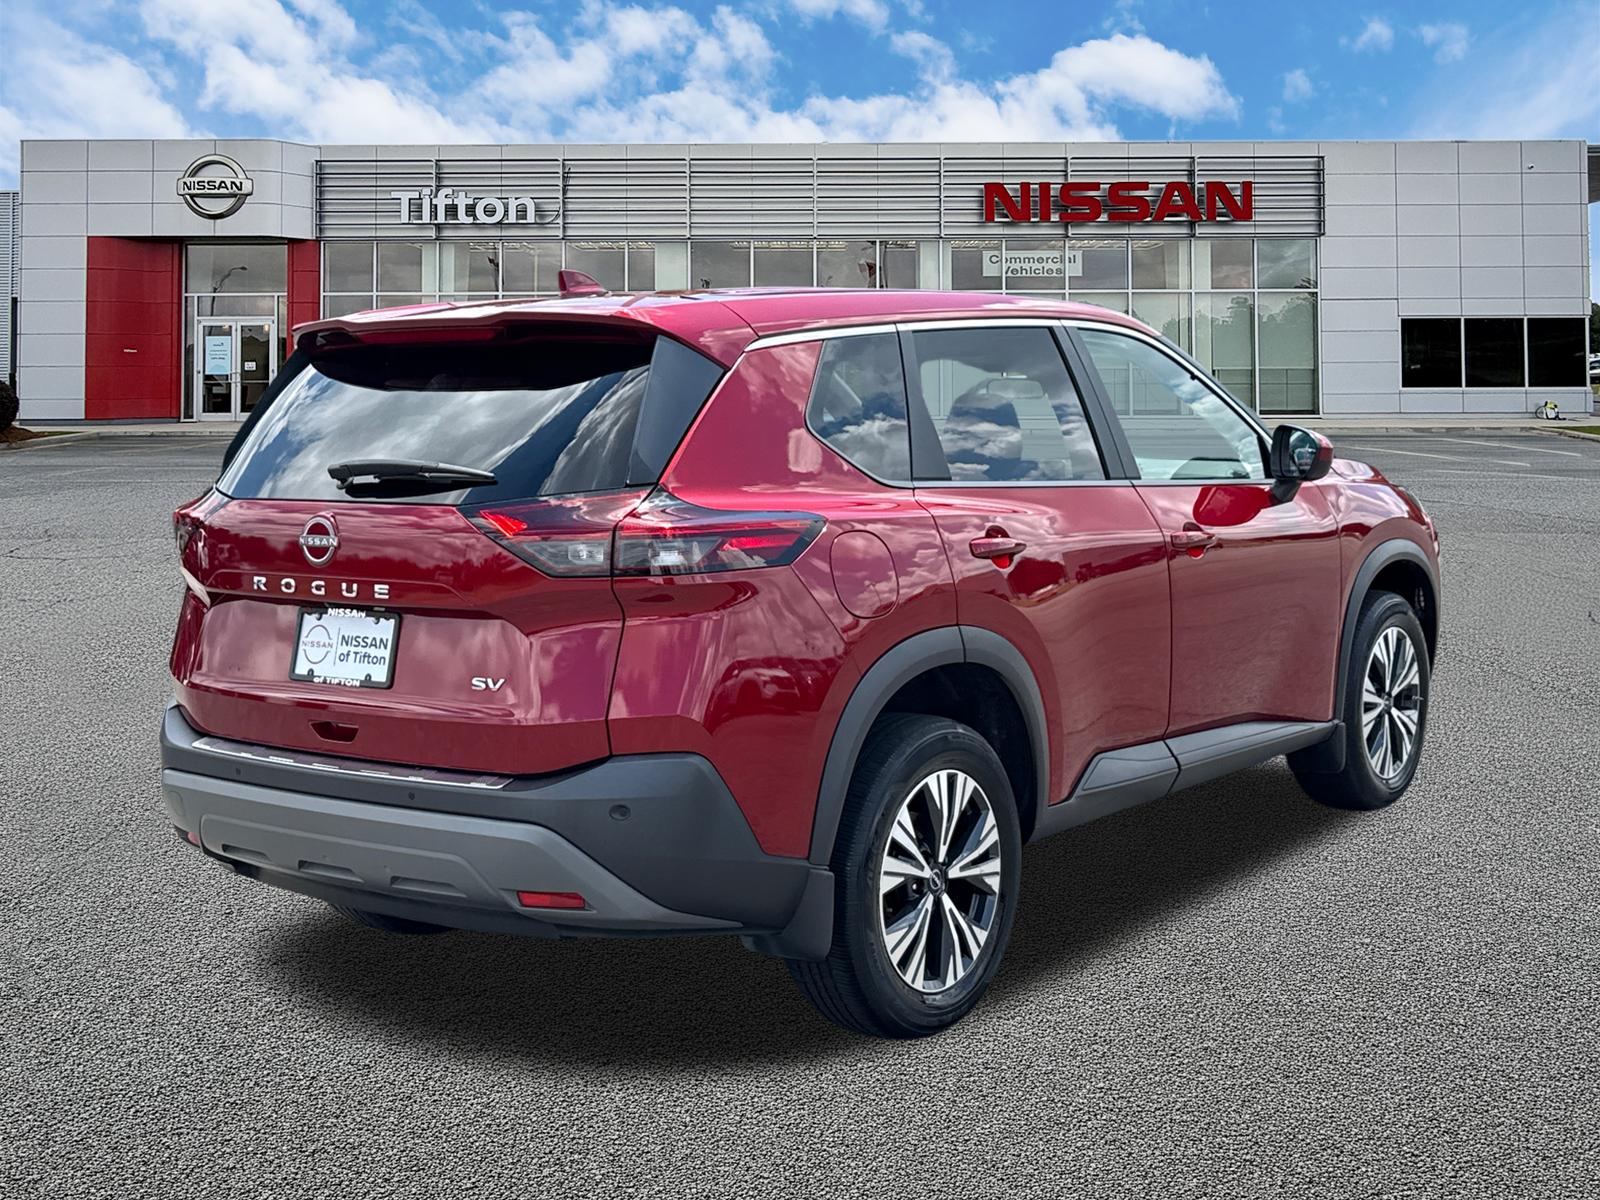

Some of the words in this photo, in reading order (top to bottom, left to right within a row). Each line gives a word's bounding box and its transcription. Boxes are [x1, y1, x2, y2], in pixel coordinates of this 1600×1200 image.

[183, 181, 243, 191] NISSAN
[391, 188, 536, 224] Tifton
[984, 181, 1253, 222] NISSAN
[300, 537, 337, 546] NISSAN
[253, 576, 390, 599] ROGUE
[327, 608, 366, 618] NISSAN
[301, 640, 333, 648] NISSAN
[340, 634, 388, 650] NISSAN
[338, 650, 351, 663] of
[353, 651, 386, 665] Tifton
[326, 677, 360, 686] TIFTON
[471, 677, 505, 691] SV
